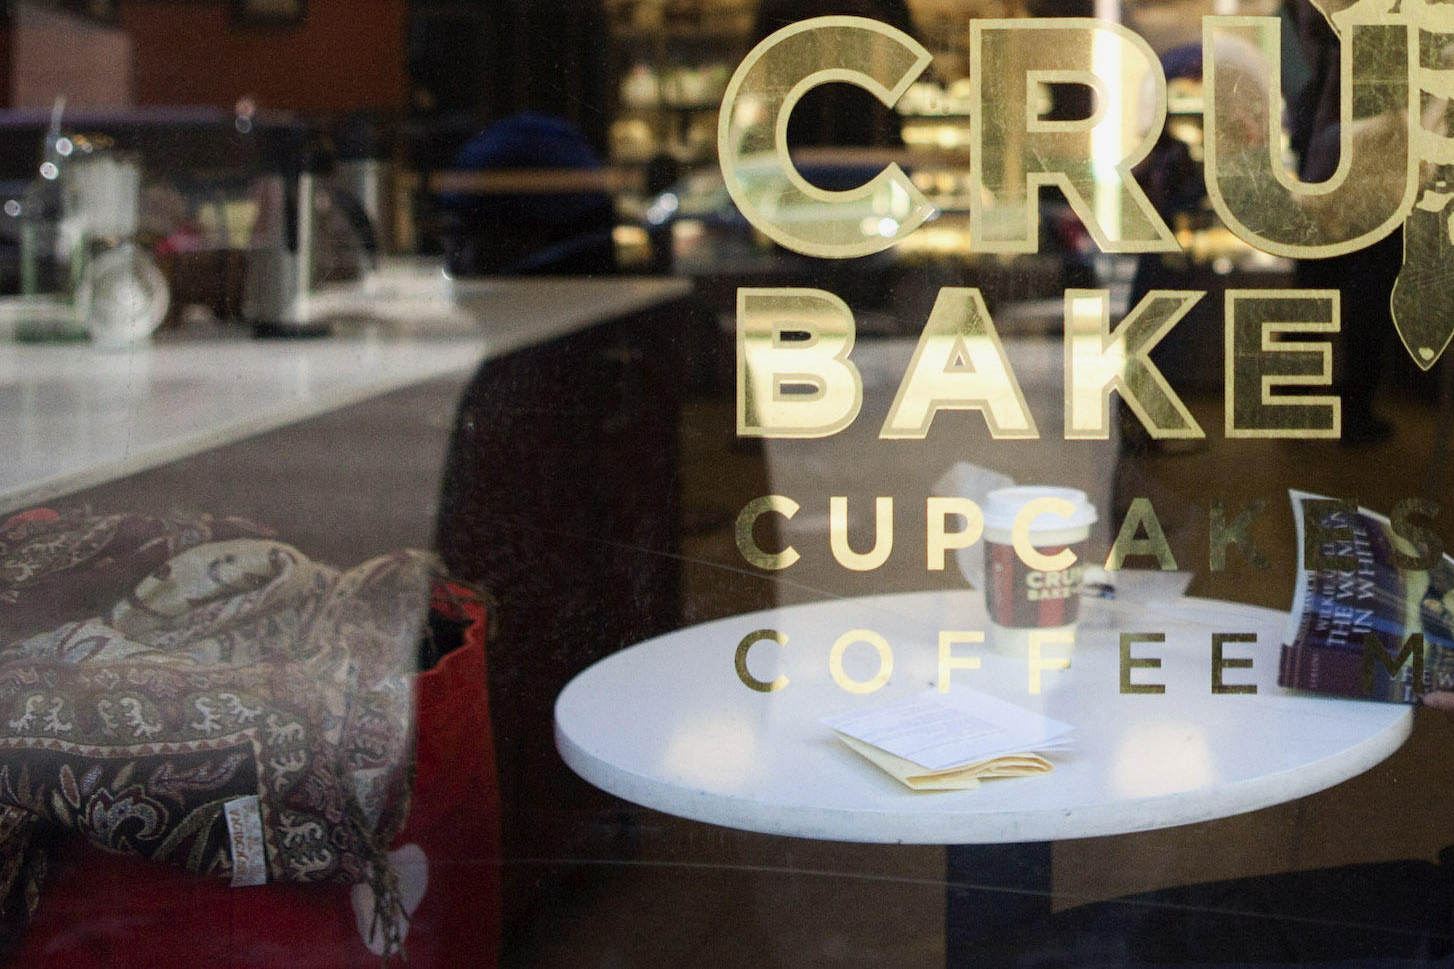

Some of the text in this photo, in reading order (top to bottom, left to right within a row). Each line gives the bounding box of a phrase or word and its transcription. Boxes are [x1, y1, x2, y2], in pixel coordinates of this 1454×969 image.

[736, 286, 1342, 440] BAKE
[735, 493, 1445, 571] CUPCAKES
[1352, 527, 1375, 634] IN WHITE
[734, 629, 1258, 694] COFFEE
